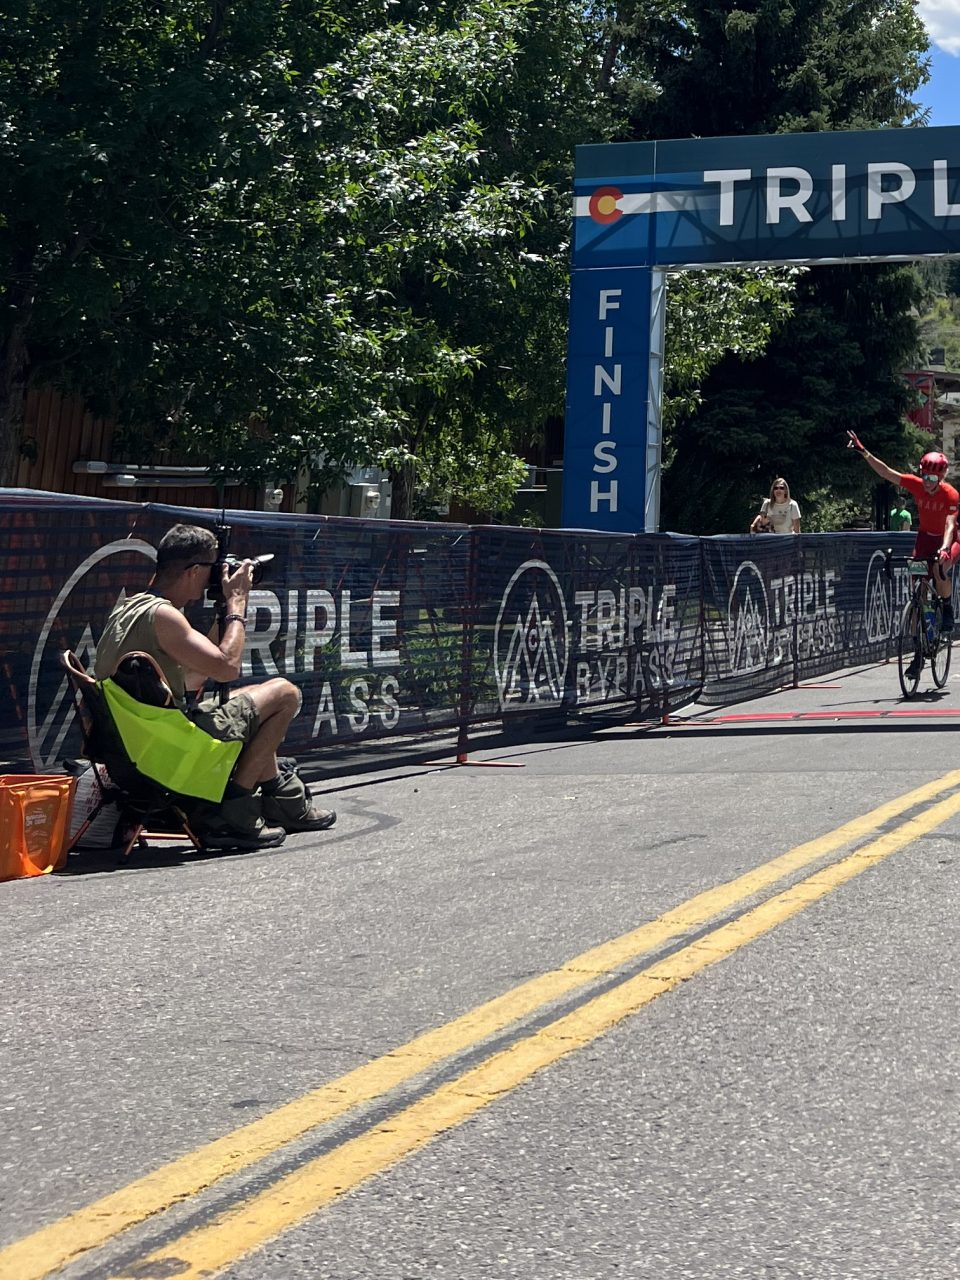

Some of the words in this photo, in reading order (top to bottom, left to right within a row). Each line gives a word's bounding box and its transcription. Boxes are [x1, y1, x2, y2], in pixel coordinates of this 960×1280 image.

[590, 289, 622, 512] FINISH
[574, 585, 677, 654] TRIPLE
[771, 570, 836, 626] TRIPLE
